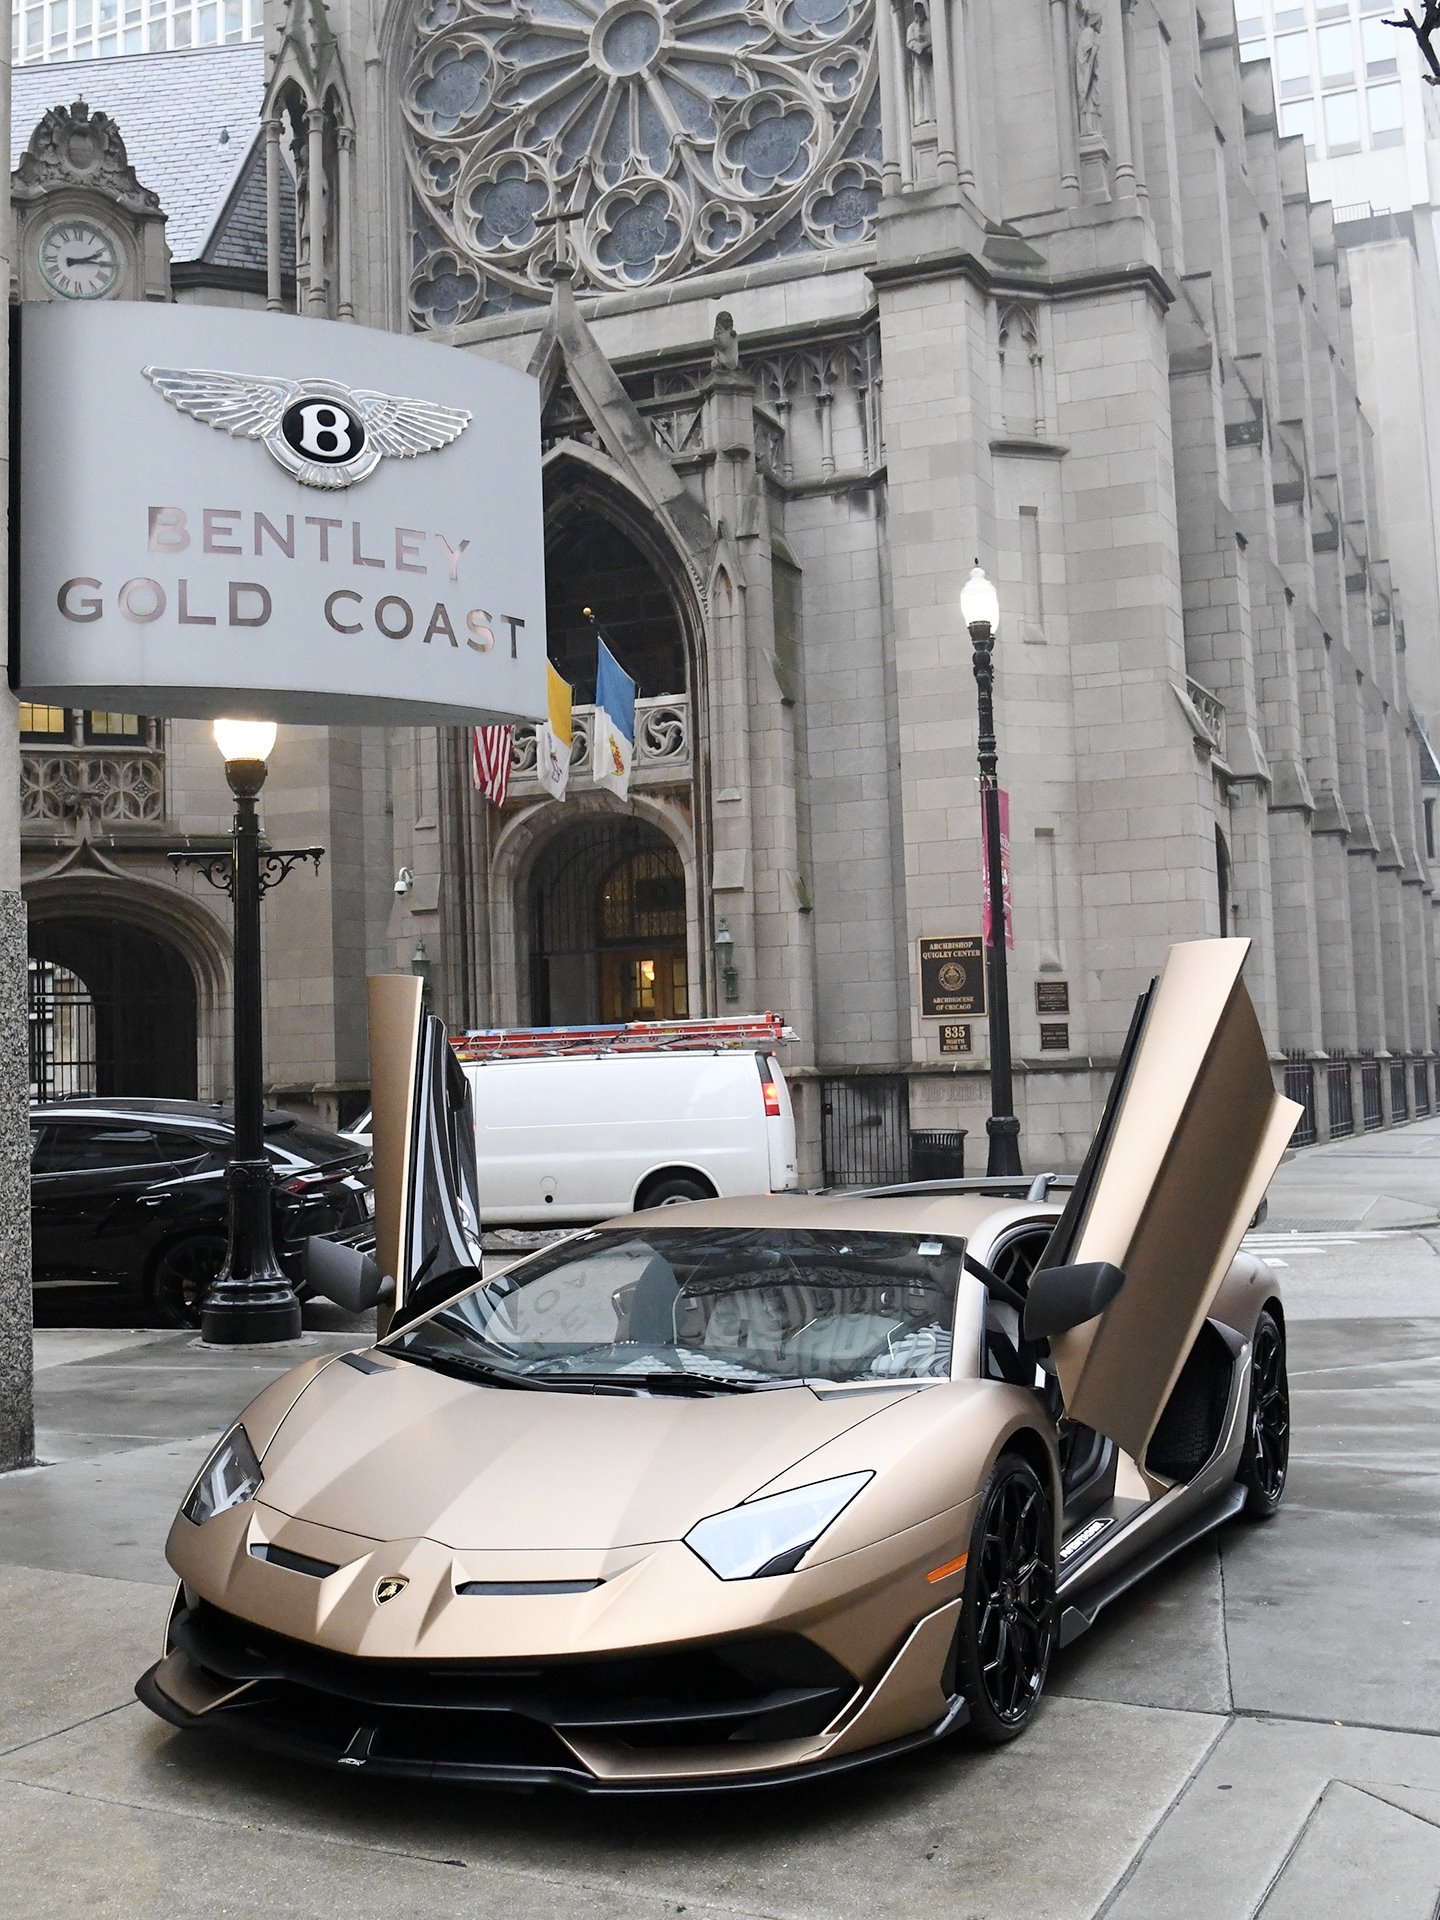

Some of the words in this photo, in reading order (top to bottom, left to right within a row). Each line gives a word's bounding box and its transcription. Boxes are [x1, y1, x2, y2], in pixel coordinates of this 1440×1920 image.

[299, 403, 352, 457] B
[147, 506, 471, 582] BENTLEY
[57, 577, 273, 628] GOLD
[323, 589, 525, 659] COAST
[929, 941, 974, 950] ARCHBISHOP
[922, 950, 952, 960] QUIGLEY
[953, 949, 981, 958] CENTER
[933, 996, 974, 1004] ARCHDIOCESE
[944, 1026, 965, 1038] 835
